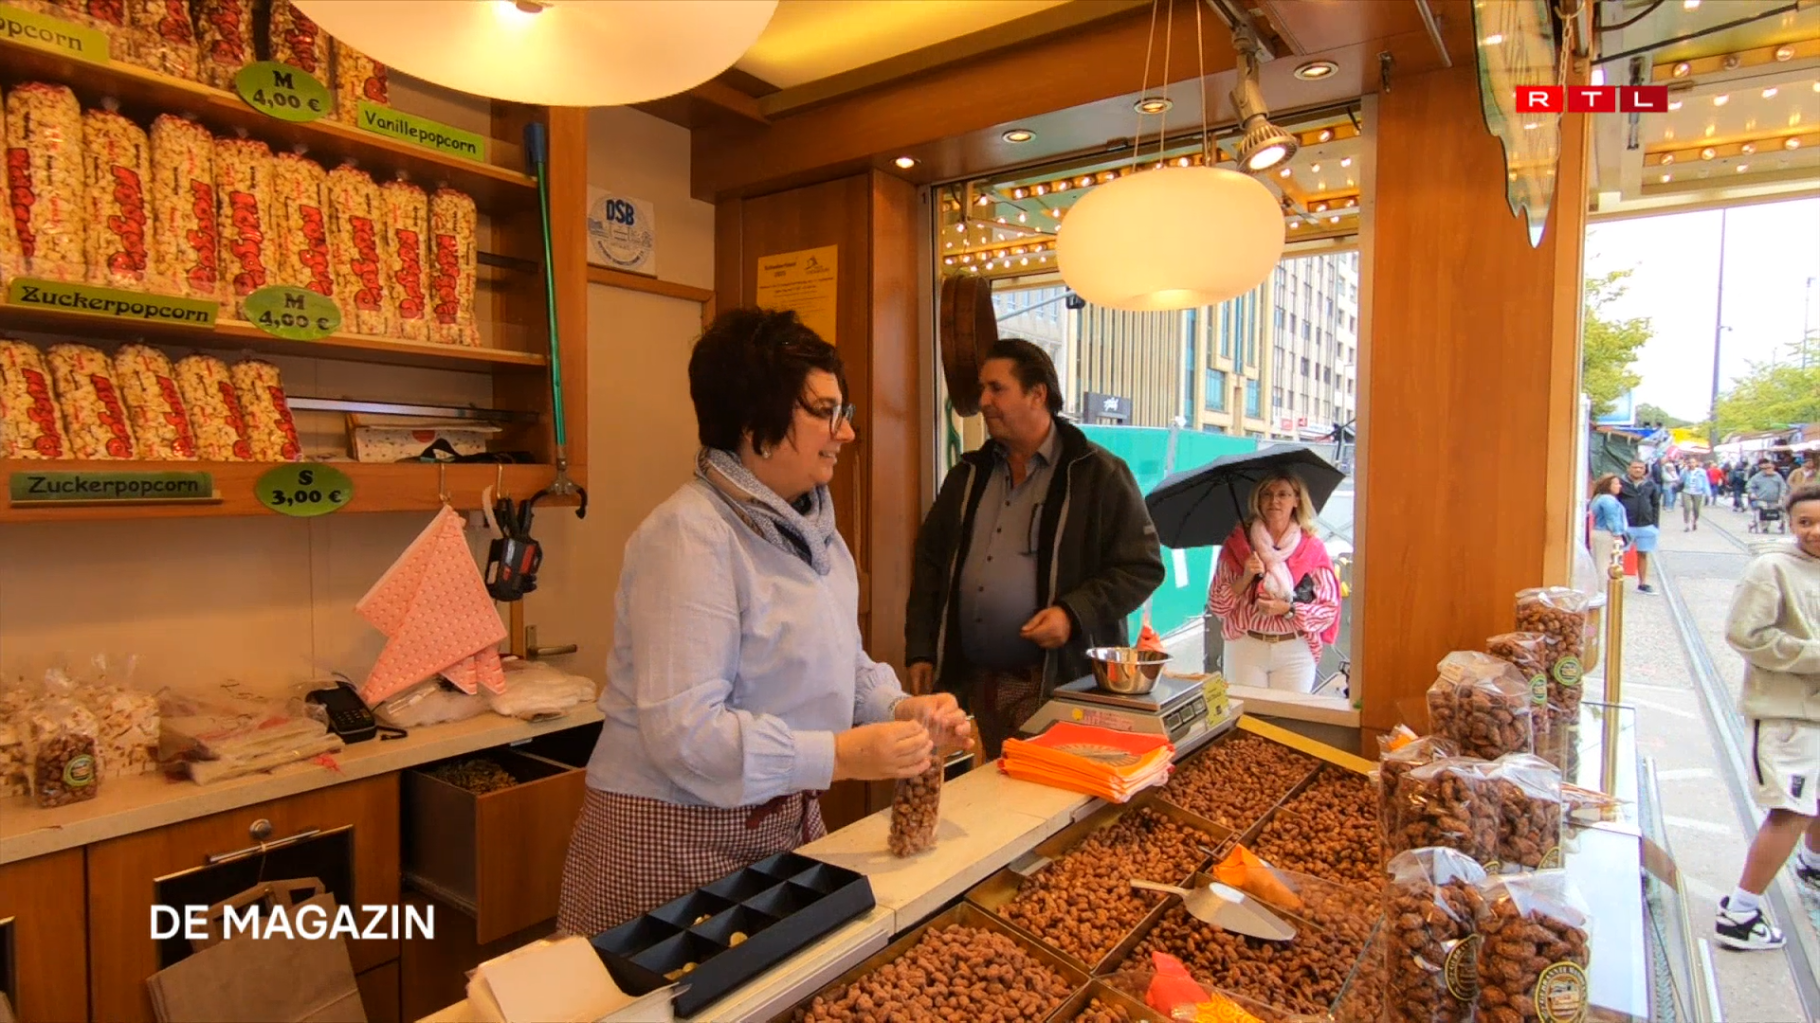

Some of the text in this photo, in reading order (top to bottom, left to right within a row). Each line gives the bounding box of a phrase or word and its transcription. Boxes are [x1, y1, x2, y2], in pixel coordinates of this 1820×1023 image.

[273, 70, 293, 89] M
[253, 88, 322, 112] 4,00 €
[365, 110, 477, 154] Vanillepopcorn
[606, 199, 635, 226] DSB
[21, 285, 209, 322] Zuckerpopcorn
[284, 292, 305, 310] M
[258, 310, 330, 330] 4,00 €
[28, 476, 199, 496] Zuckerpopcorn
[298, 470, 314, 486] S
[271, 489, 342, 506] 3,00 €
